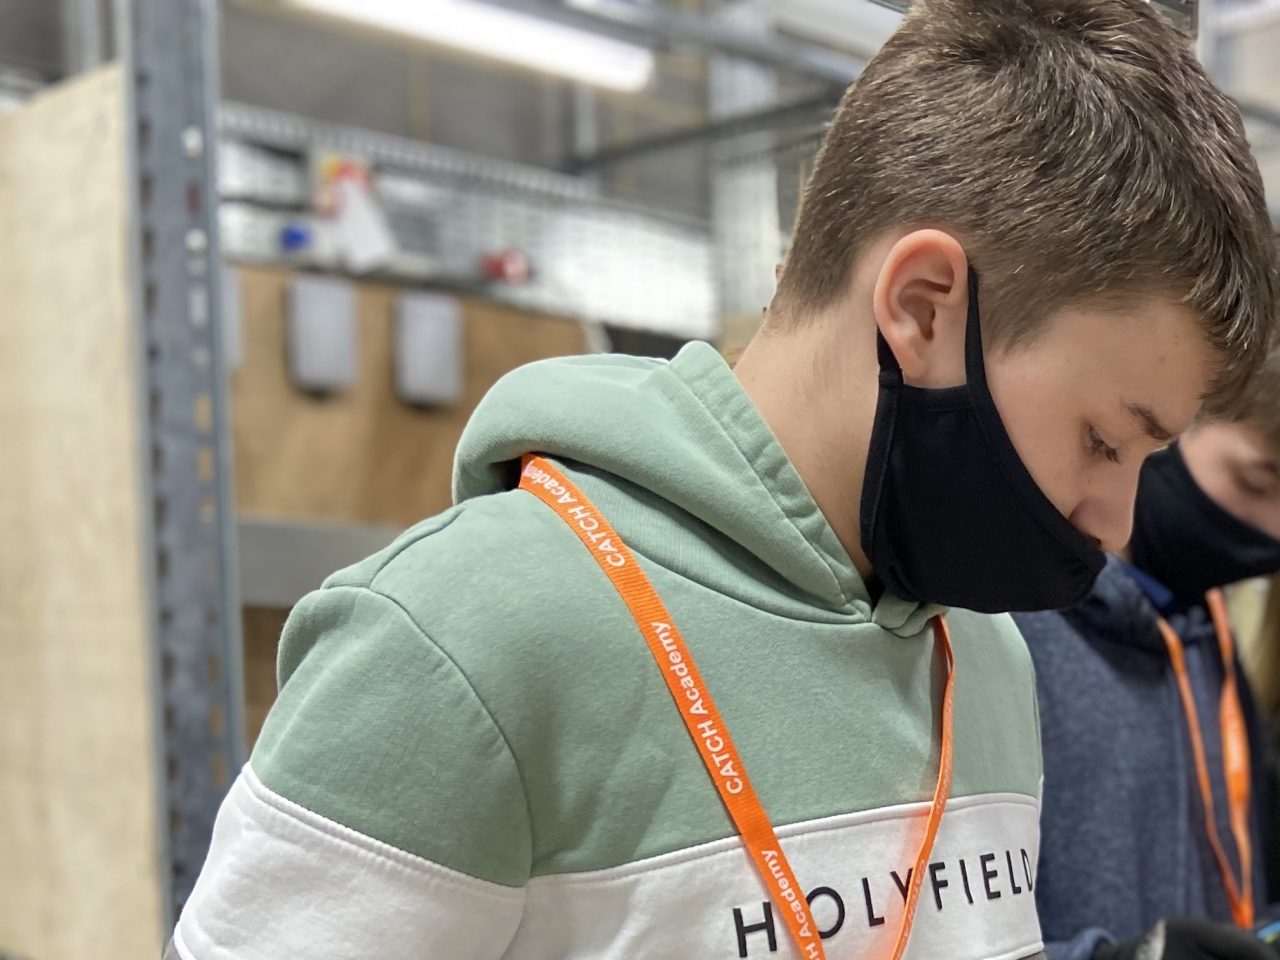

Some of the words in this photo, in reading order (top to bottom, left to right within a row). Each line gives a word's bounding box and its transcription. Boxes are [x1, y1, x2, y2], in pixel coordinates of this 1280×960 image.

[523, 465, 578, 504] Academ
[567, 505, 626, 567] CATCH
[651, 621, 708, 716] Academy
[697, 719, 744, 794] CATCH
[733, 848, 1033, 958] HOLYFIELD
[761, 850, 813, 938] Academy
